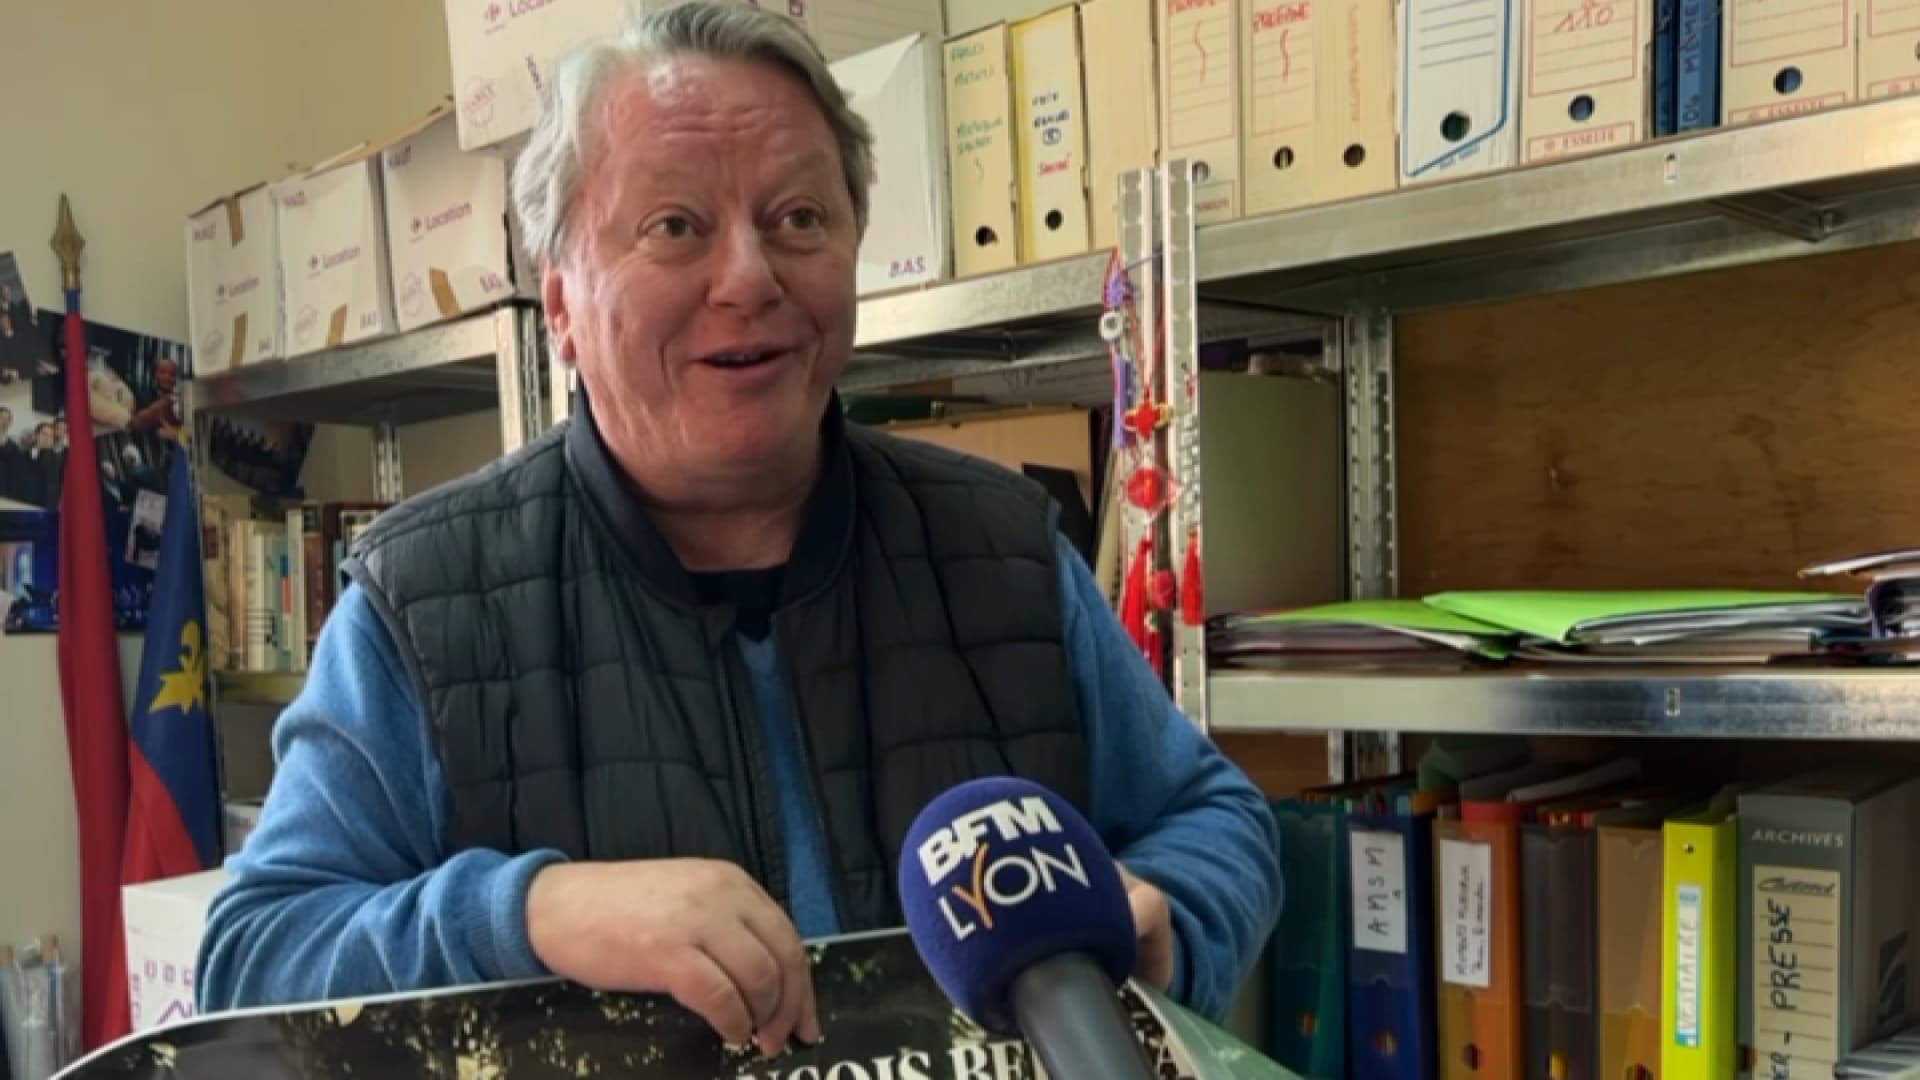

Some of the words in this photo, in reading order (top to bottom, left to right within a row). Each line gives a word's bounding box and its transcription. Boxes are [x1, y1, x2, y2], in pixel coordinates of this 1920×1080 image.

[425, 203, 472, 230] Location
[917, 797, 1064, 887] BFM
[1752, 829, 1844, 848] ARCHIVES
[937, 842, 1092, 941] LYON
[1768, 898, 1802, 1012] PRESSE
